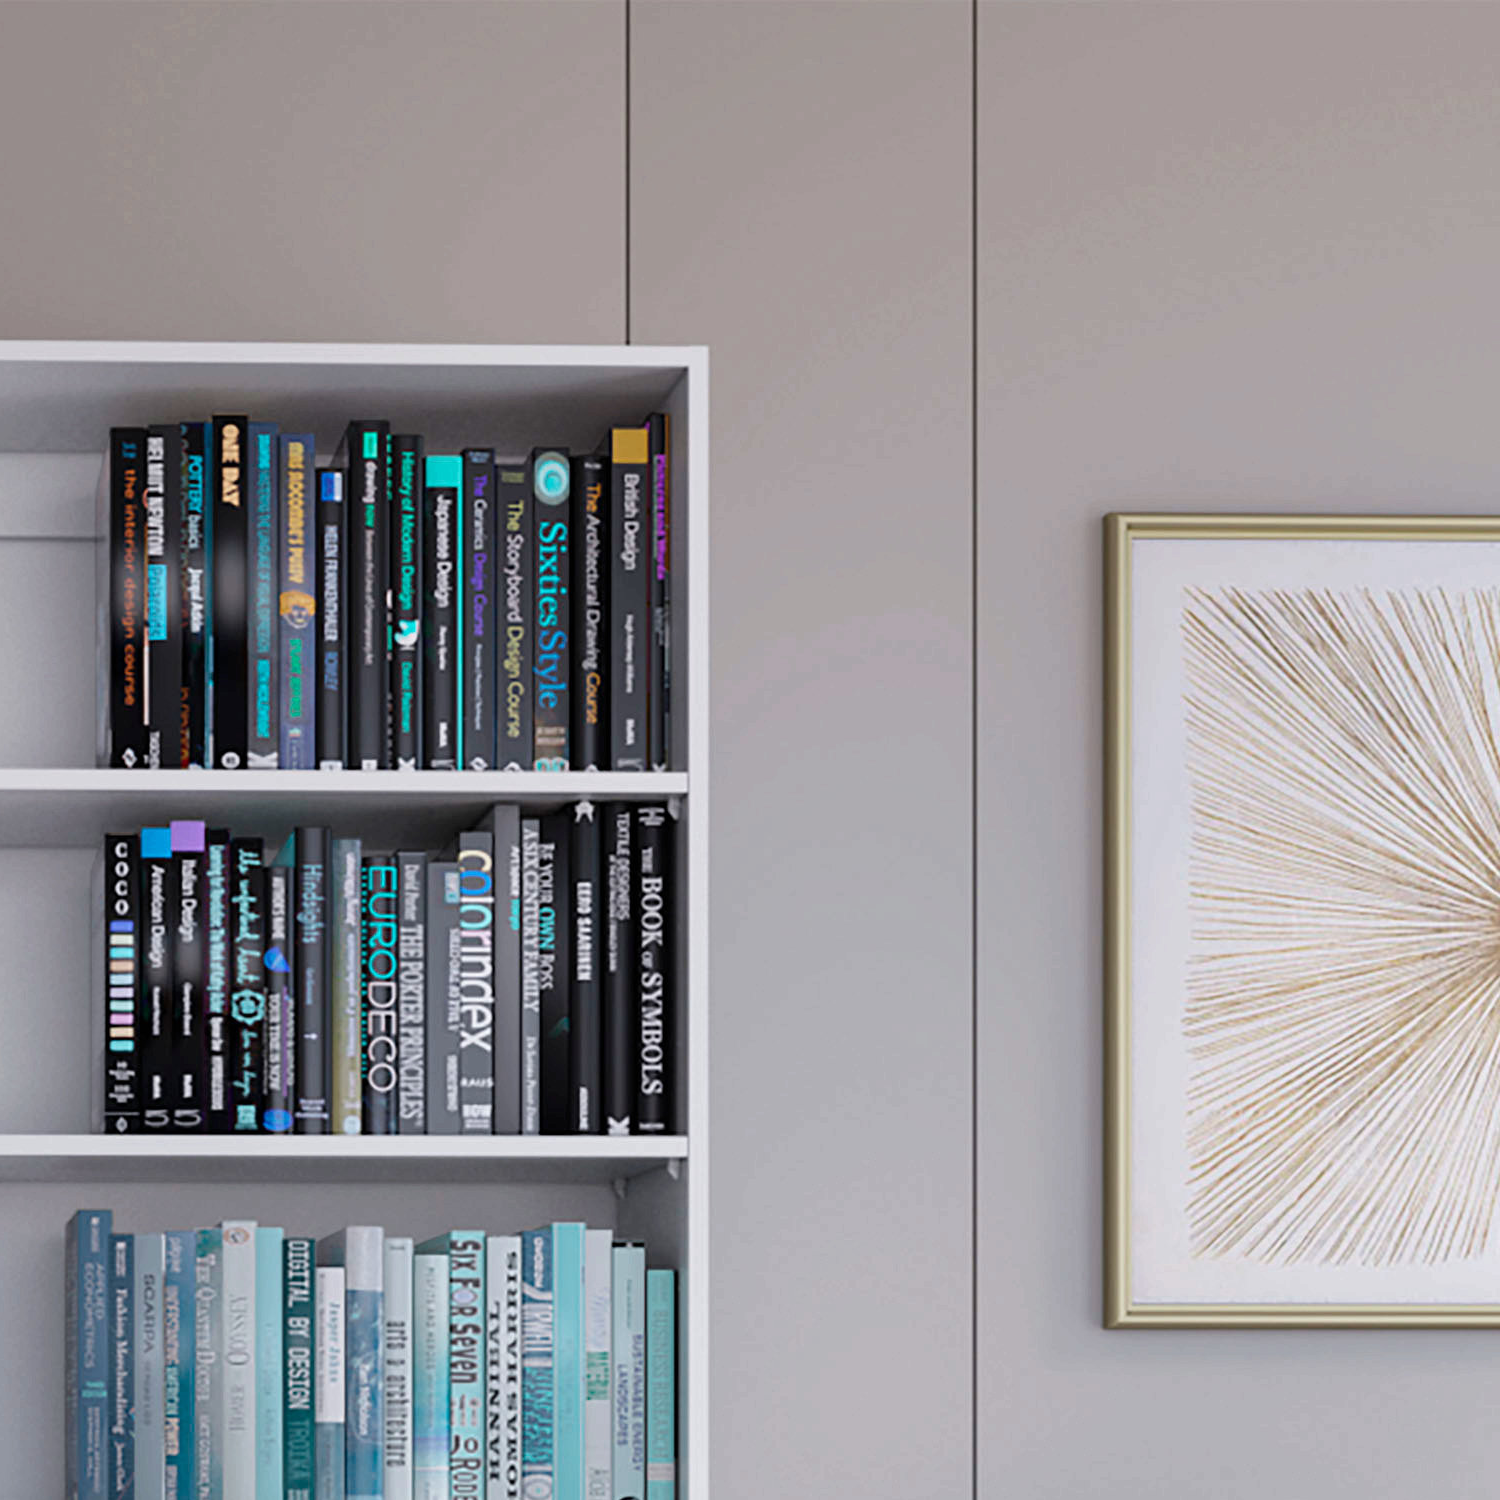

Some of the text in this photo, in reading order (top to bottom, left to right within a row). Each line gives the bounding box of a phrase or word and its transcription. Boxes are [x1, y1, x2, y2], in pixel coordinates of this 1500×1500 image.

[125, 469, 136, 500] the
[148, 437, 163, 555] HELMUT NEWTON
[188, 455, 203, 548] POTTERY basics
[221, 424, 239, 506] ONE DAY
[362, 461, 376, 503] drawing
[473, 475, 486, 496] The
[587, 484, 600, 511] The
[125, 504, 136, 570] interior
[400, 451, 414, 610] History of Modern Design
[435, 495, 452, 607] Japanese Design
[473, 499, 486, 549] Ceramics
[507, 501, 523, 531] The
[621, 474, 638, 570] British Design
[324, 526, 338, 640] HELEN FRANKENTHALER
[472, 553, 486, 591] Design
[504, 534, 523, 622] Storyboard
[538, 522, 567, 627] Sixties
[587, 514, 600, 605] Architectural
[123, 573, 136, 639] design
[473, 594, 486, 635] Course
[583, 610, 600, 669] Drawing
[125, 644, 134, 705] course
[504, 626, 523, 678] Design
[533, 631, 566, 708] Style
[507, 682, 523, 738] Course
[587, 672, 600, 723] Course
[114, 841, 130, 916] COCO
[178, 859, 196, 942] Italian Design
[297, 864, 324, 943] Hindsights
[617, 813, 629, 920] TEXTILE DESIGNERS
[148, 866, 164, 968] American Design
[523, 829, 538, 1013] A SIX CENTURY FAMILY
[540, 907, 554, 949] OWN
[577, 882, 591, 981] EERO SAARINEN
[641, 848, 662, 1094] THE BOOK OF SYMBOLS
[400, 924, 422, 1119] THE PORTER PRINCIPLES
[84, 1263, 94, 1368] ECONOMETRICS
[96, 1263, 105, 1320] APPLIED
[116, 1288, 128, 1337] Fashion
[143, 1274, 154, 1353] SCARPA
[288, 1240, 309, 1409] DIGITAL BY DESIGN
[507, 1251, 518, 1383] HARRIS
[111, 1341, 127, 1435] Merchandising
[489, 1301, 501, 1481] HANNIBAL
[632, 1334, 643, 1419] SUSTAINABLE
